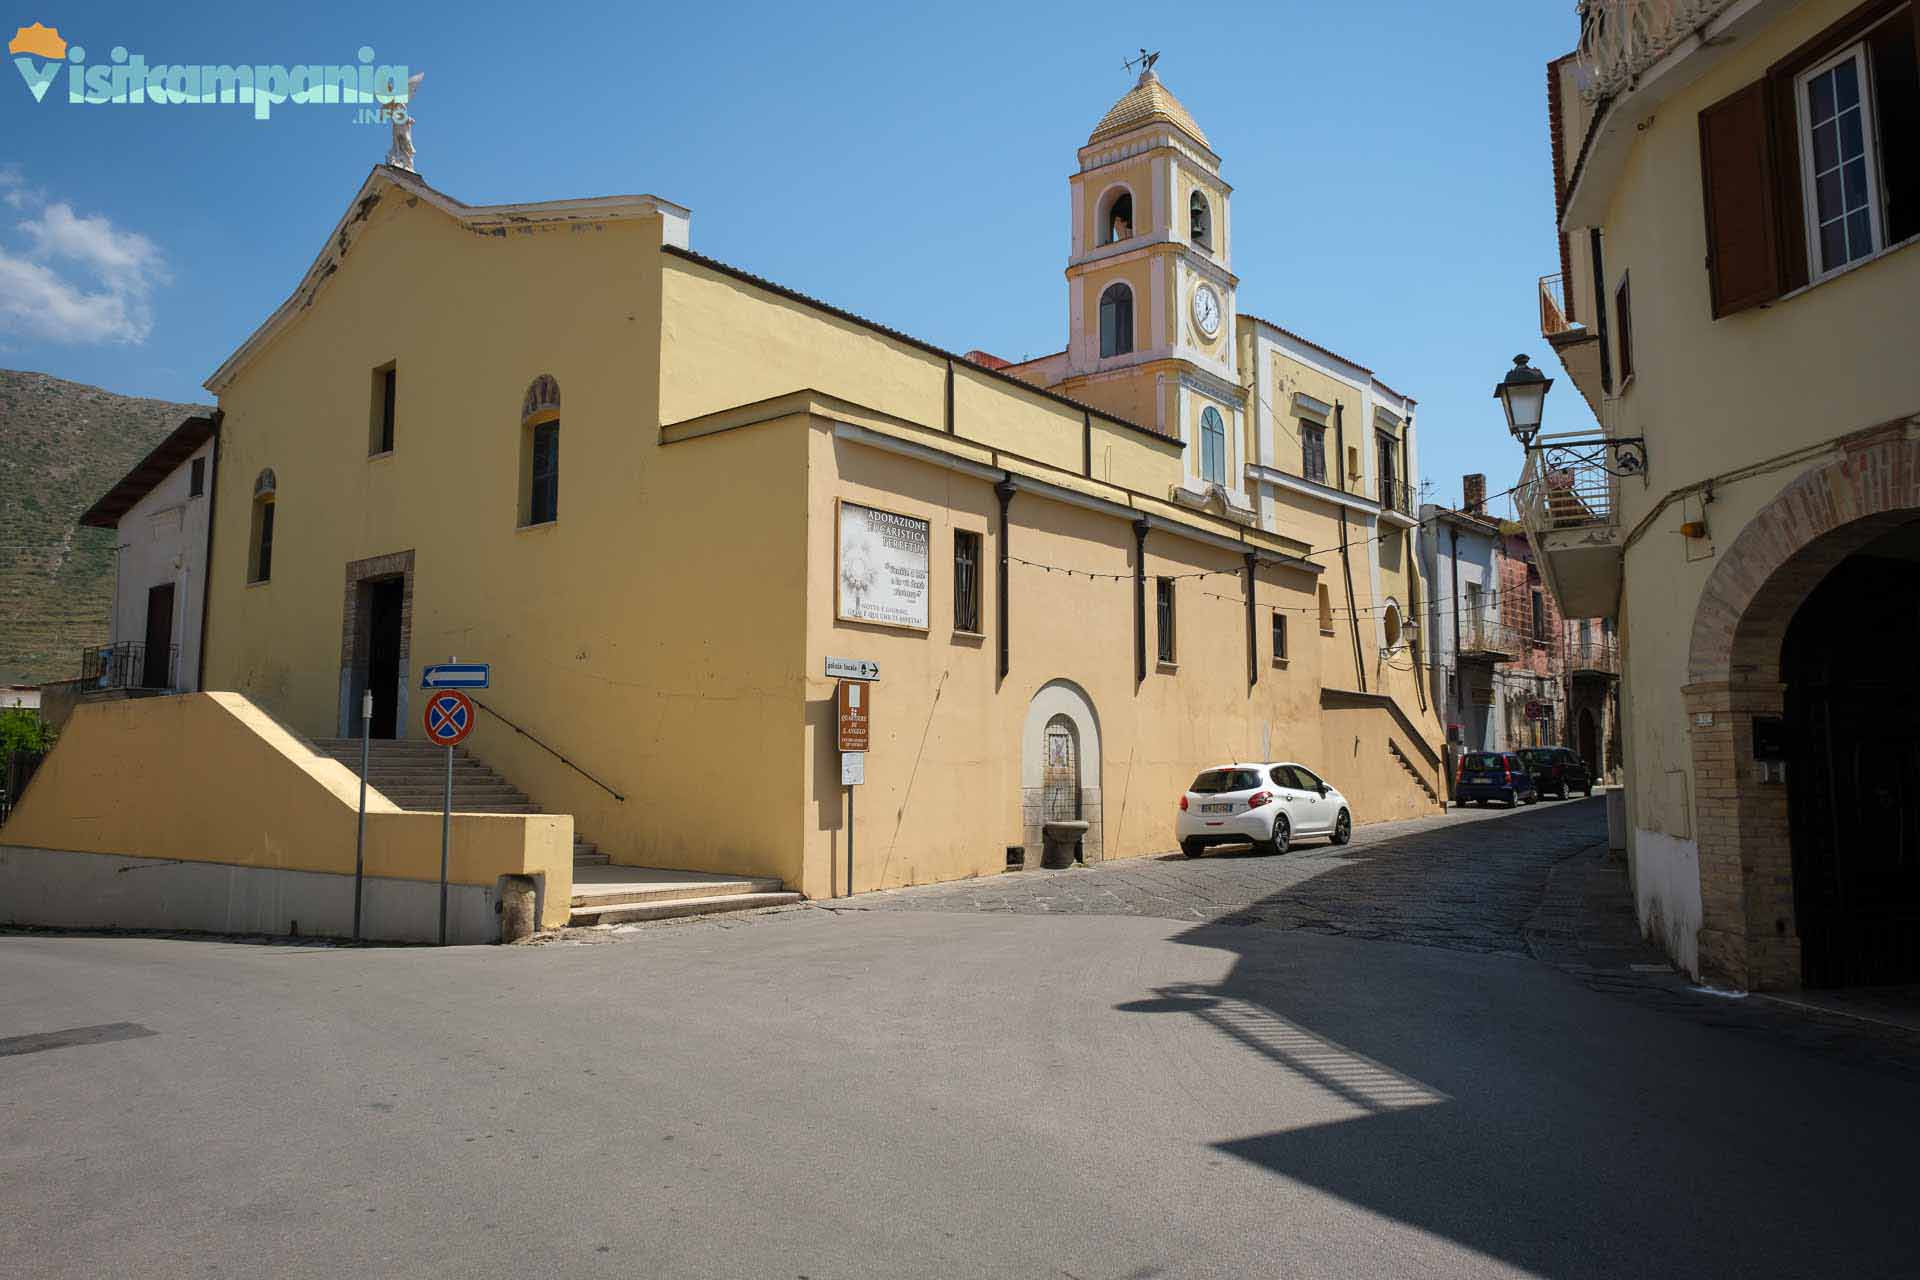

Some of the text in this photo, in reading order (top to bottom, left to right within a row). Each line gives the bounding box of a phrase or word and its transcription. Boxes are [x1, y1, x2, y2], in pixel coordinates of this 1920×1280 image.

[868, 511, 927, 531] ADORAZIONE
[867, 521, 926, 543] EUCARISTICA
[882, 535, 927, 554] PERPETUA
